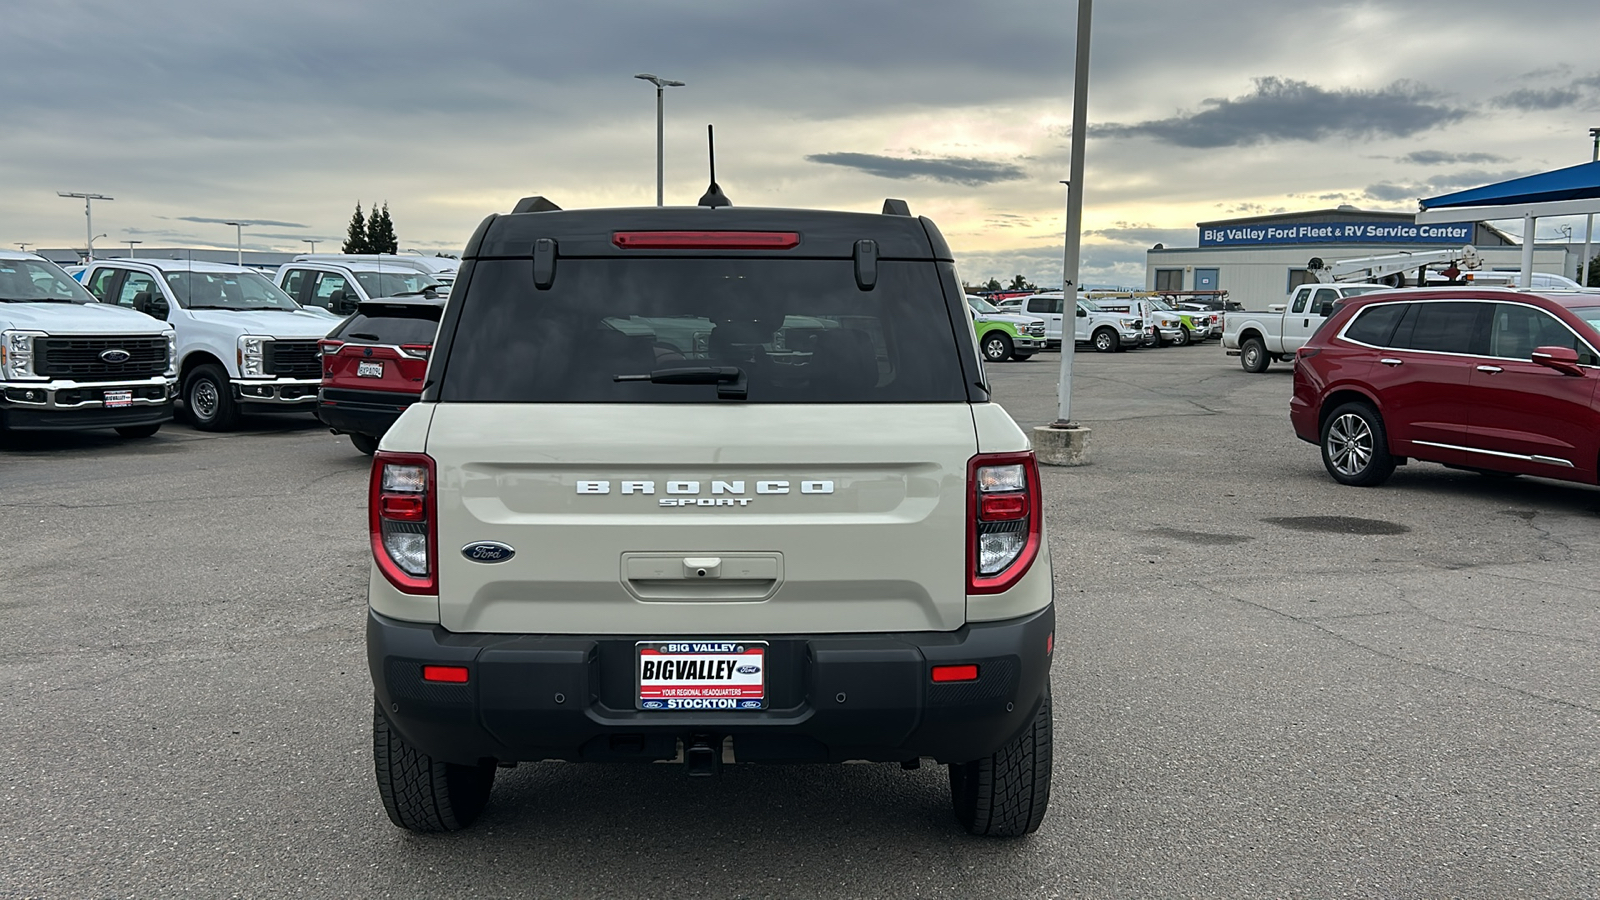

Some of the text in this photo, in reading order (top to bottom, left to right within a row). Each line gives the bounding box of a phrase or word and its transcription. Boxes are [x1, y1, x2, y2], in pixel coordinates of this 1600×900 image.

[1204, 225, 1468, 242] Big Valley Ford Fleet & RV Service Center
[576, 480, 835, 495] BRONCO
[658, 497, 753, 507] SPORT
[472, 545, 502, 559] Ford
[668, 643, 736, 652] BIG VALLEY
[642, 660, 738, 680] BIGVALLEY
[662, 688, 742, 696] YOUR REGIONAL HEADQUARTERS
[667, 699, 737, 708] STOCKTON
